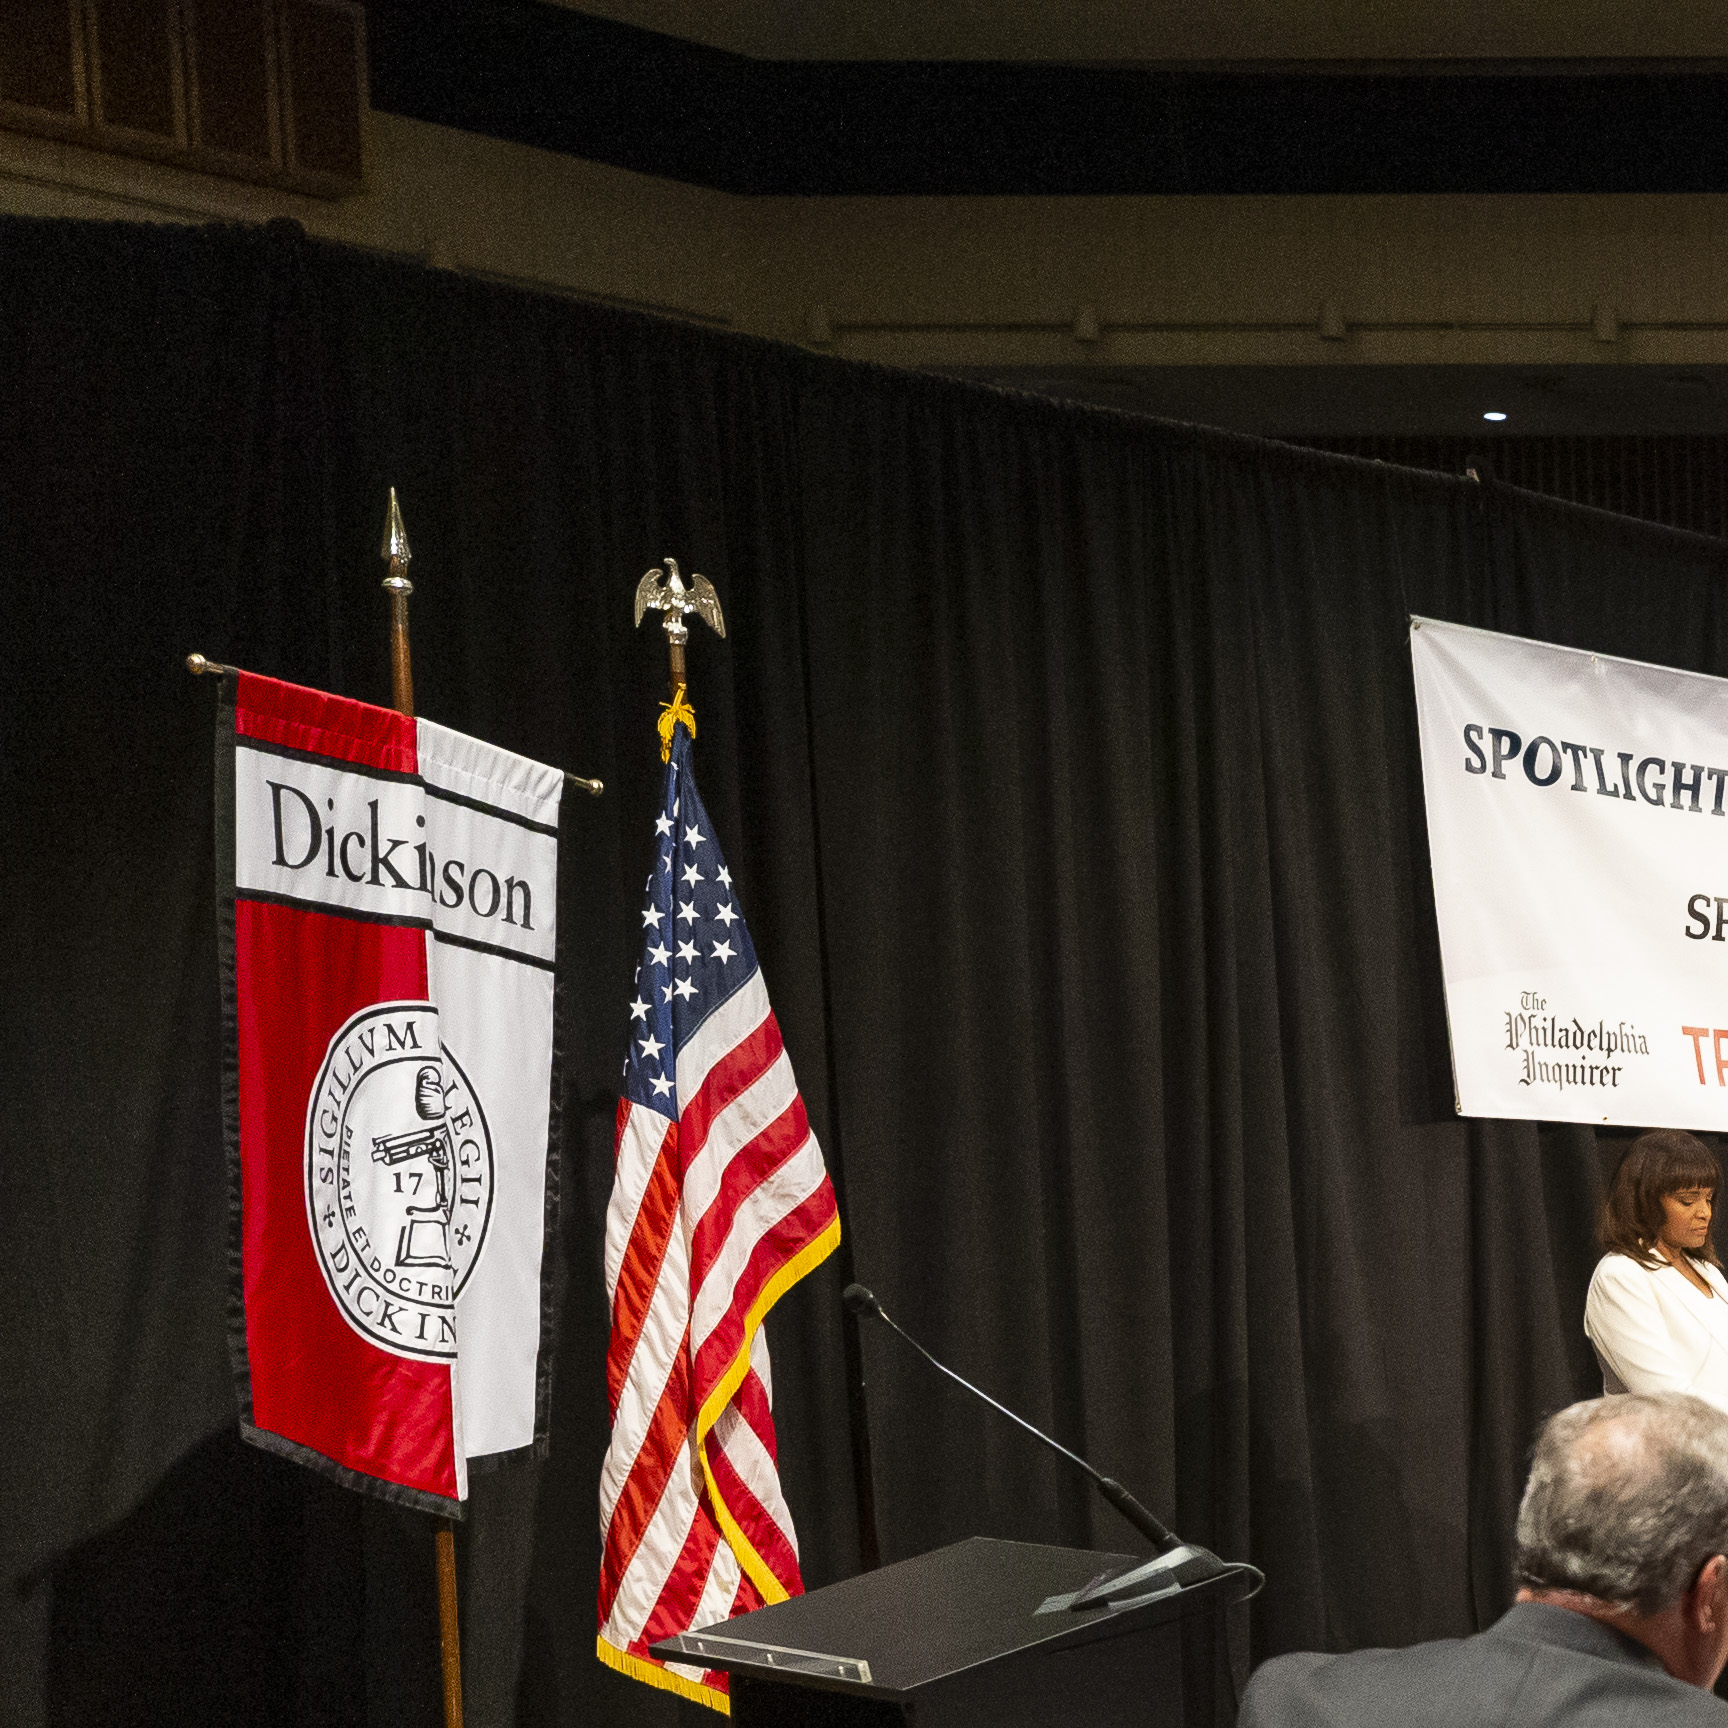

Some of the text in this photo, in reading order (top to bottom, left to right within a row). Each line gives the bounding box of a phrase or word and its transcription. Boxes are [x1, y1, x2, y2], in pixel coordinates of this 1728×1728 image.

[1520, 990, 1547, 1012] The
[1504, 1010, 1650, 1059] Philadelphia
[1518, 1049, 1624, 1091] Inquirer
[318, 1020, 423, 1186] SIGILLVM
[369, 1256, 450, 1300] DOCTRI
